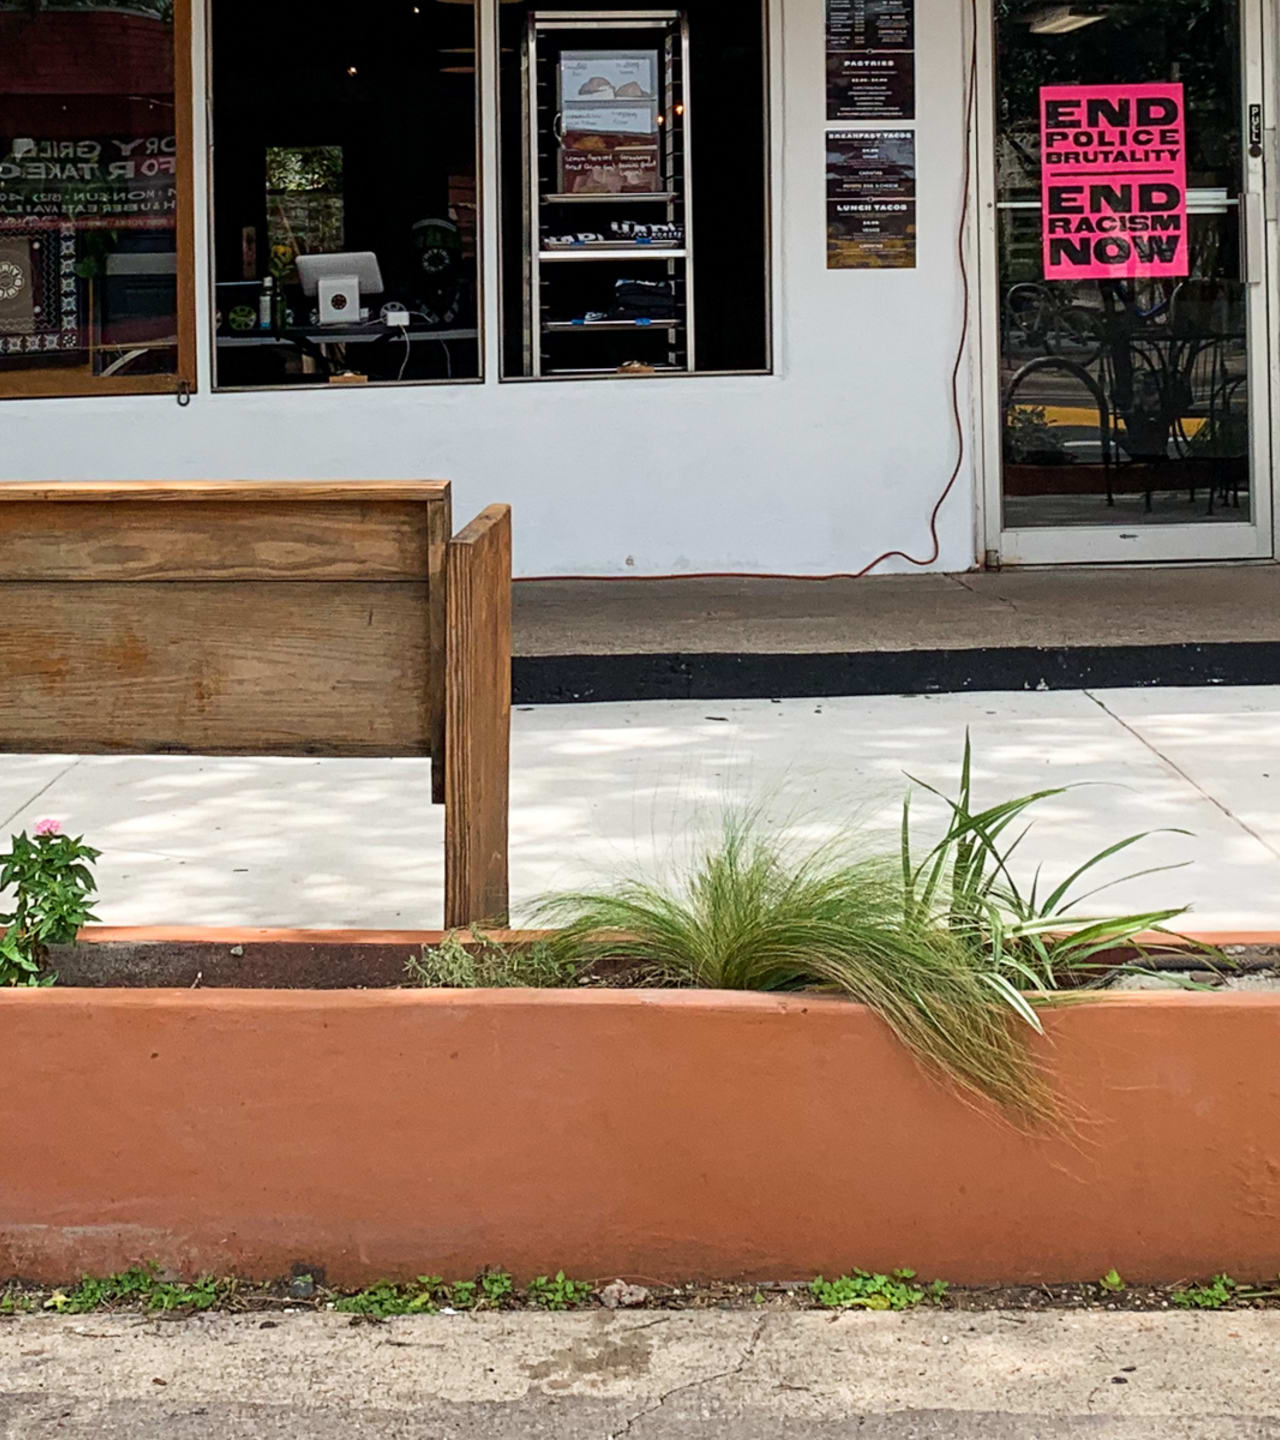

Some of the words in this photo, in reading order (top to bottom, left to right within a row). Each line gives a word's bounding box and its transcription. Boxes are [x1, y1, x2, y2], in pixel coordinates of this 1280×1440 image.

[1045, 98, 1179, 128] END
[1251, 106, 1260, 142] PULL
[1045, 129, 1180, 148] POLICE
[1045, 148, 1181, 164] BRUTALITY
[1048, 183, 1181, 214] END
[1048, 215, 1181, 234] RACISM
[1048, 235, 1180, 266] NOW
